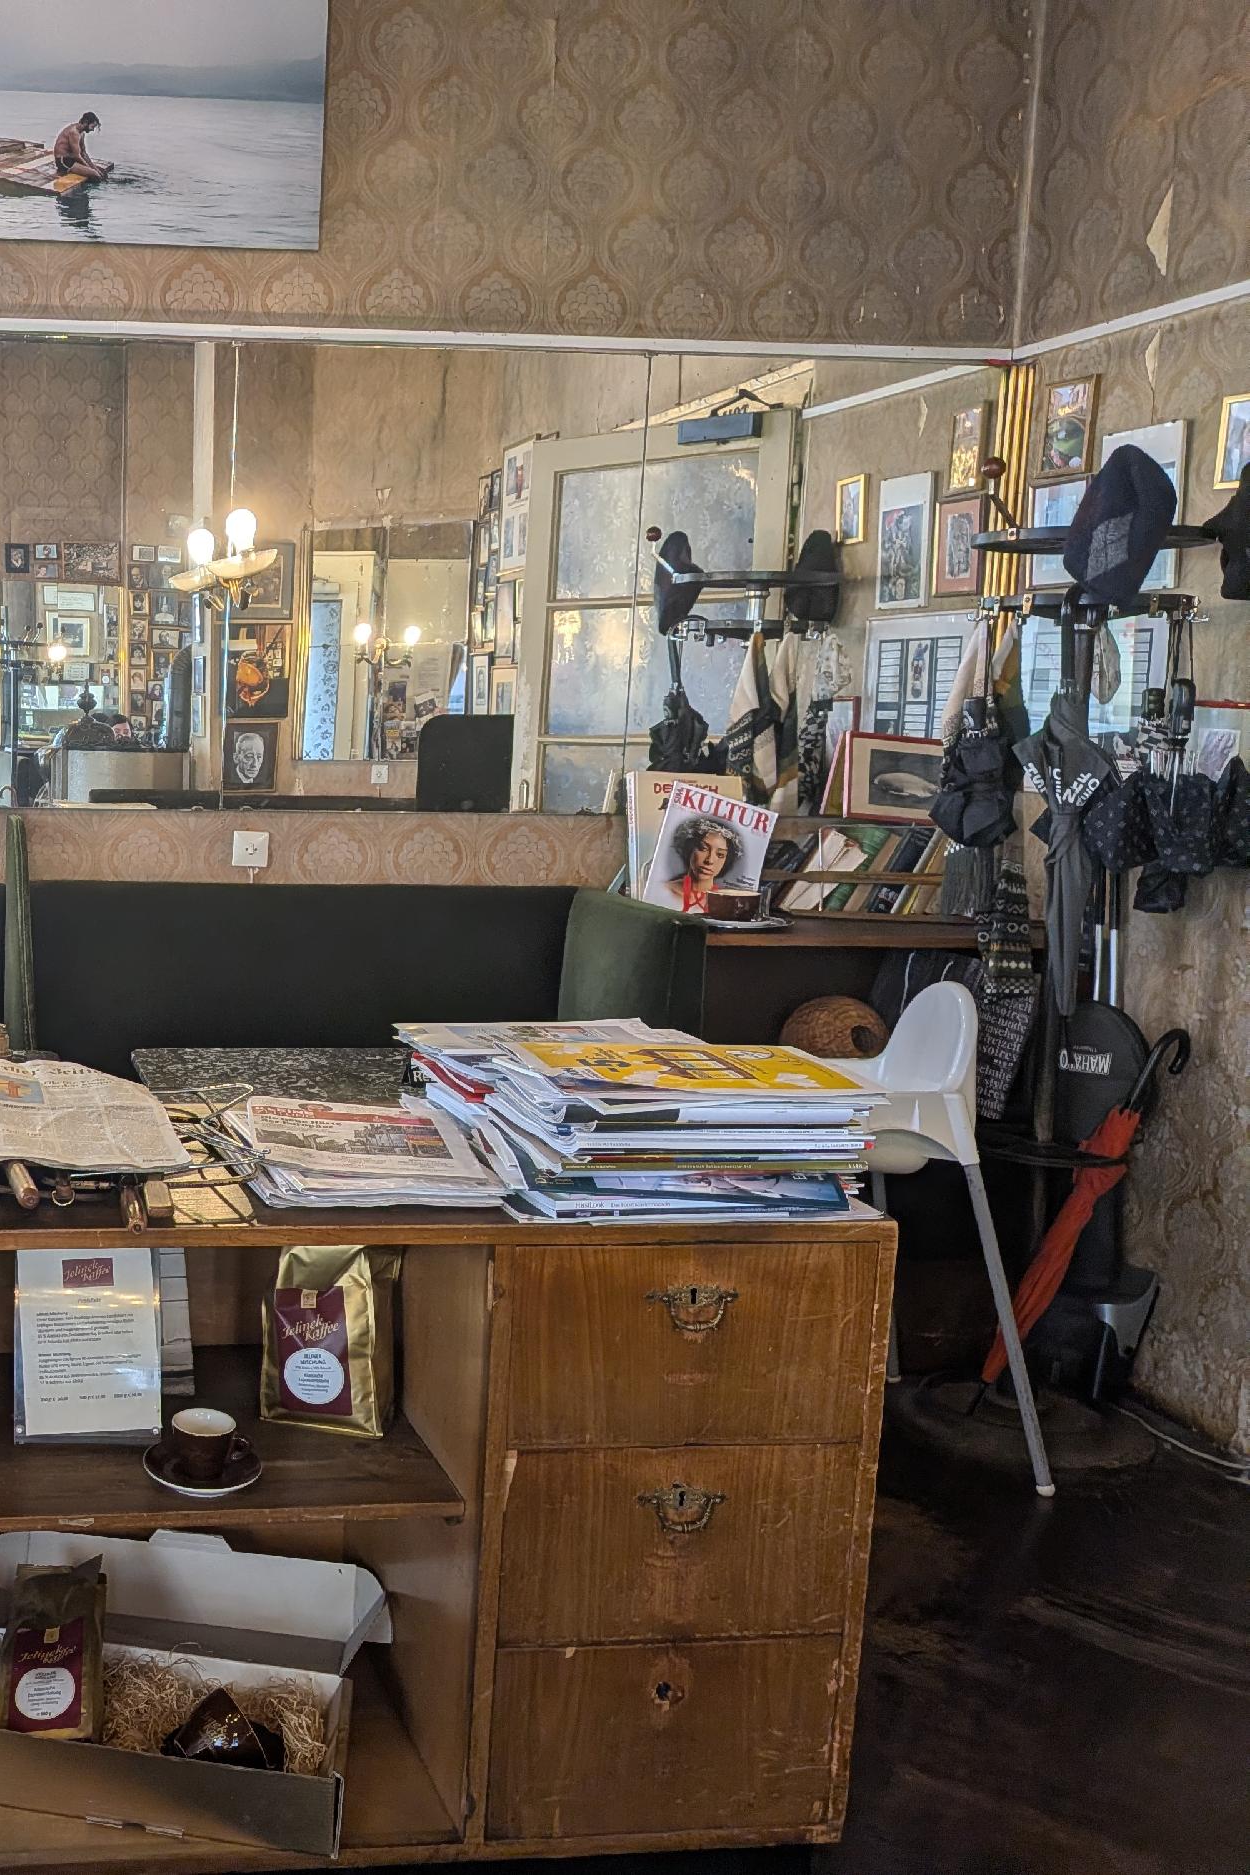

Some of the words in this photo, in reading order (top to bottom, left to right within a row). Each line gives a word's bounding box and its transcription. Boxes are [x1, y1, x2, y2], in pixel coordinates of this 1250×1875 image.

[681, 787, 770, 834] KULTUR
[282, 1314, 324, 1340] Jelinek
[302, 1320, 340, 1343] Kaffee
